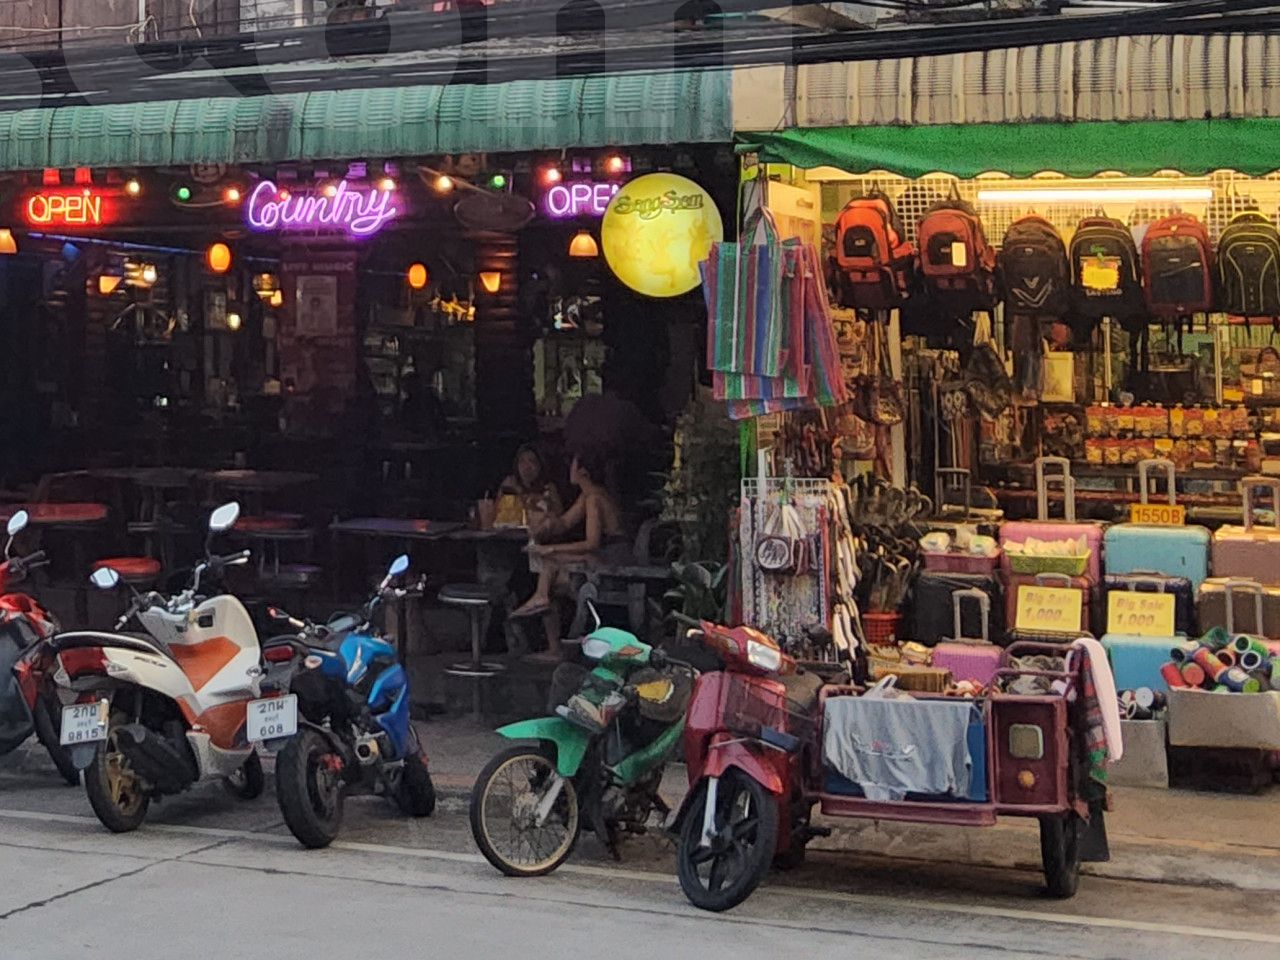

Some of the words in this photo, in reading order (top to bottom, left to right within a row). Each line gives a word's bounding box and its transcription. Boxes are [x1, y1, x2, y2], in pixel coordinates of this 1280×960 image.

[548, 183, 620, 215] OPE
[28, 194, 101, 224] OPEN
[250, 181, 395, 233] Country
[1025, 592, 1044, 605] Big
[1049, 593, 1071, 604] Sale
[1116, 598, 1135, 611] Big
[1140, 599, 1165, 610] Sale
[1025, 607, 1062, 623] 1,000
[1116, 614, 1154, 628] 1,000
[260, 724, 283, 737] 608
